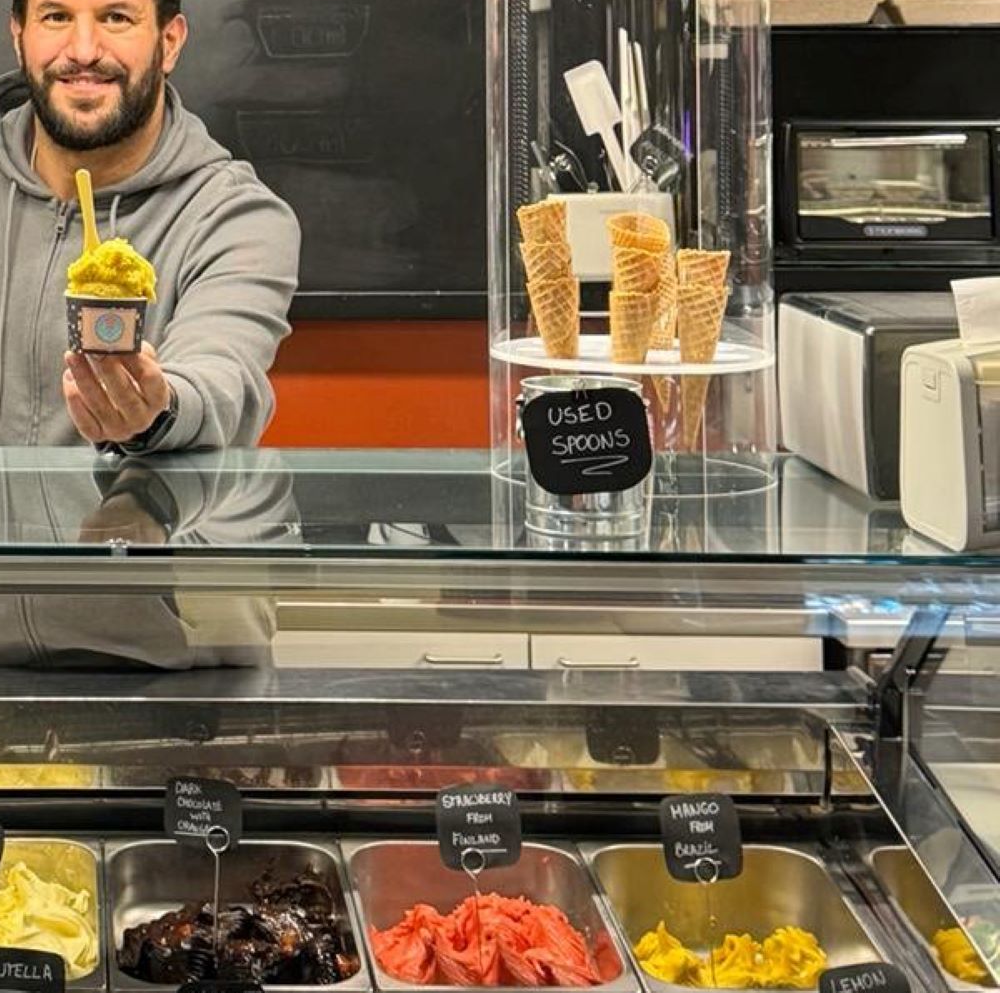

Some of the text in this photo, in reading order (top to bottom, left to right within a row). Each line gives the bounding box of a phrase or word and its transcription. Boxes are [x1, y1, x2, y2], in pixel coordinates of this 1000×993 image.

[547, 401, 612, 426] USED
[551, 428, 630, 455] SPOONS
[669, 801, 720, 820] MANGO
